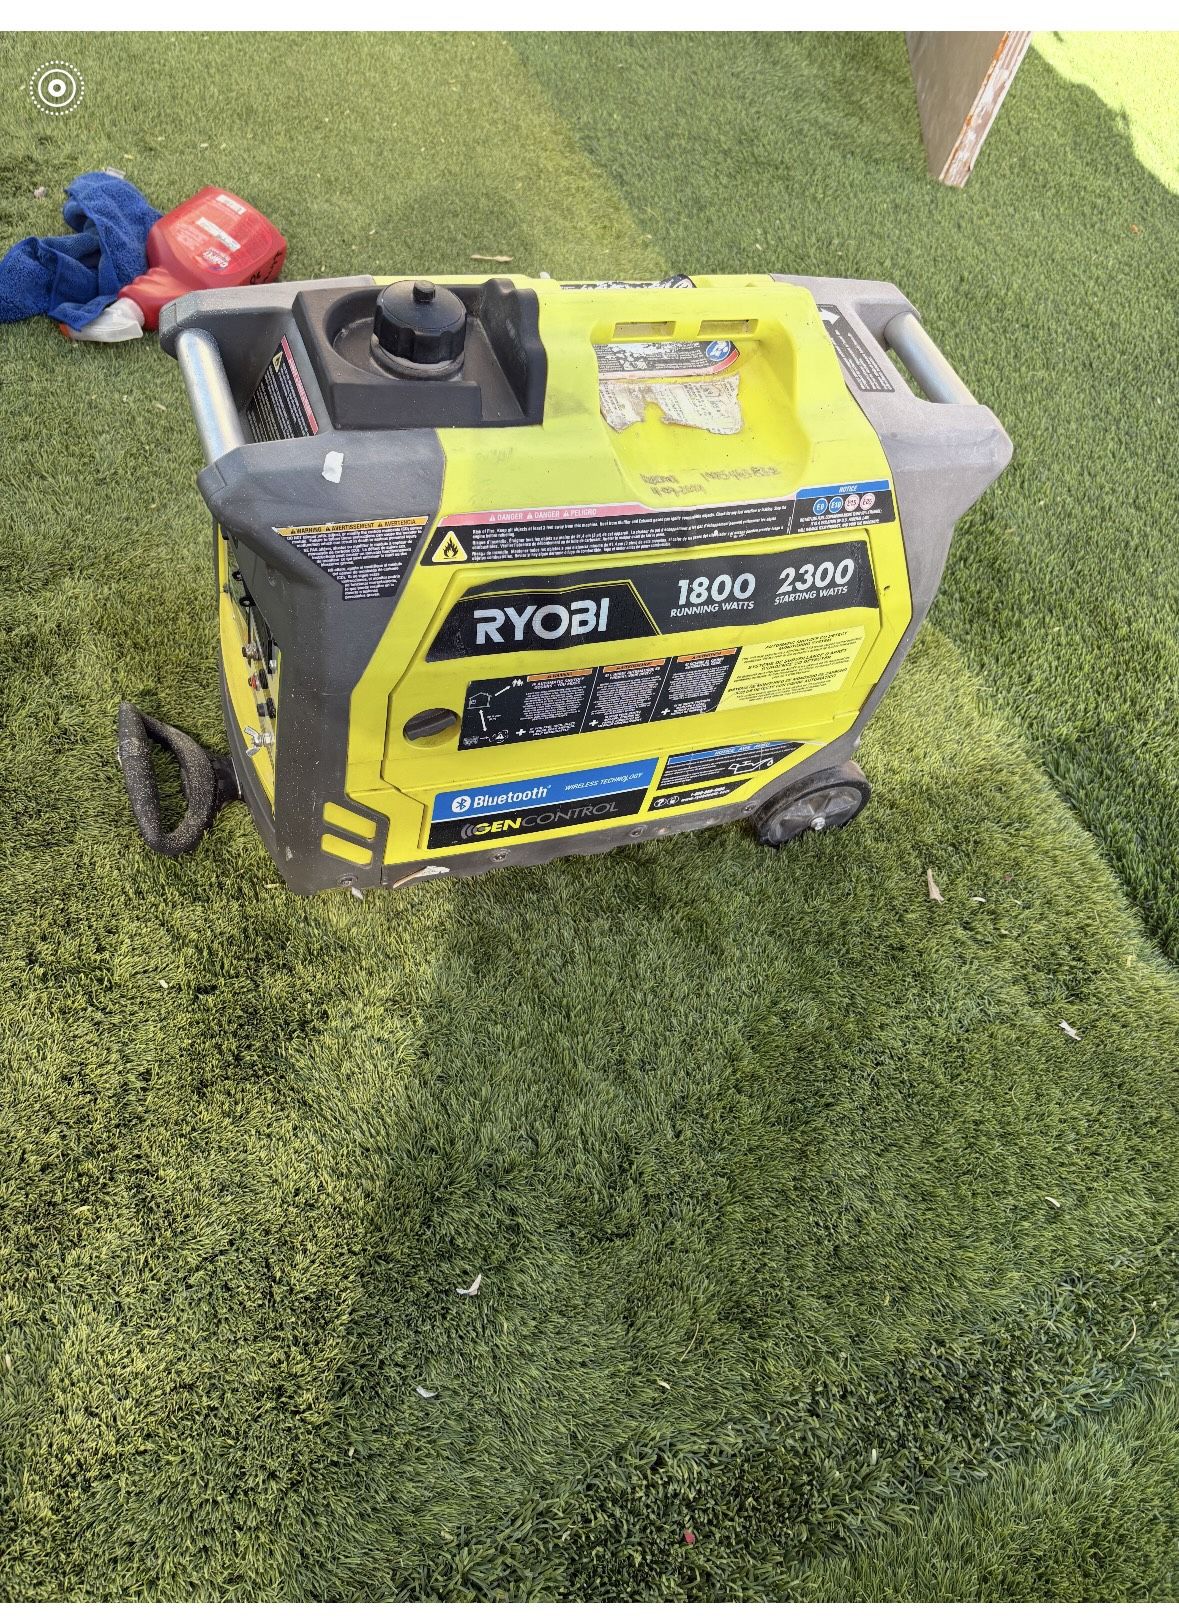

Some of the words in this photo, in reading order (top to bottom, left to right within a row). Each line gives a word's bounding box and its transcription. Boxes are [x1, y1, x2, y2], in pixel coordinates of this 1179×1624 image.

[838, 485, 858, 493] NOTICE
[497, 513, 523, 521] DANGER
[534, 510, 560, 519] DANGER
[570, 508, 597, 517] PELIGRO
[677, 572, 757, 606] 1800
[776, 560, 855, 595] 2300
[773, 591, 816, 606] STARTING
[819, 585, 848, 598] WATTS
[669, 603, 719, 618] RUNNING
[722, 599, 755, 612] WATTS
[473, 597, 610, 645] RYOBI
[473, 786, 548, 809] Bluetooth
[564, 780, 599, 792] WIRELESS
[600, 772, 644, 785] TECHNOLOGY
